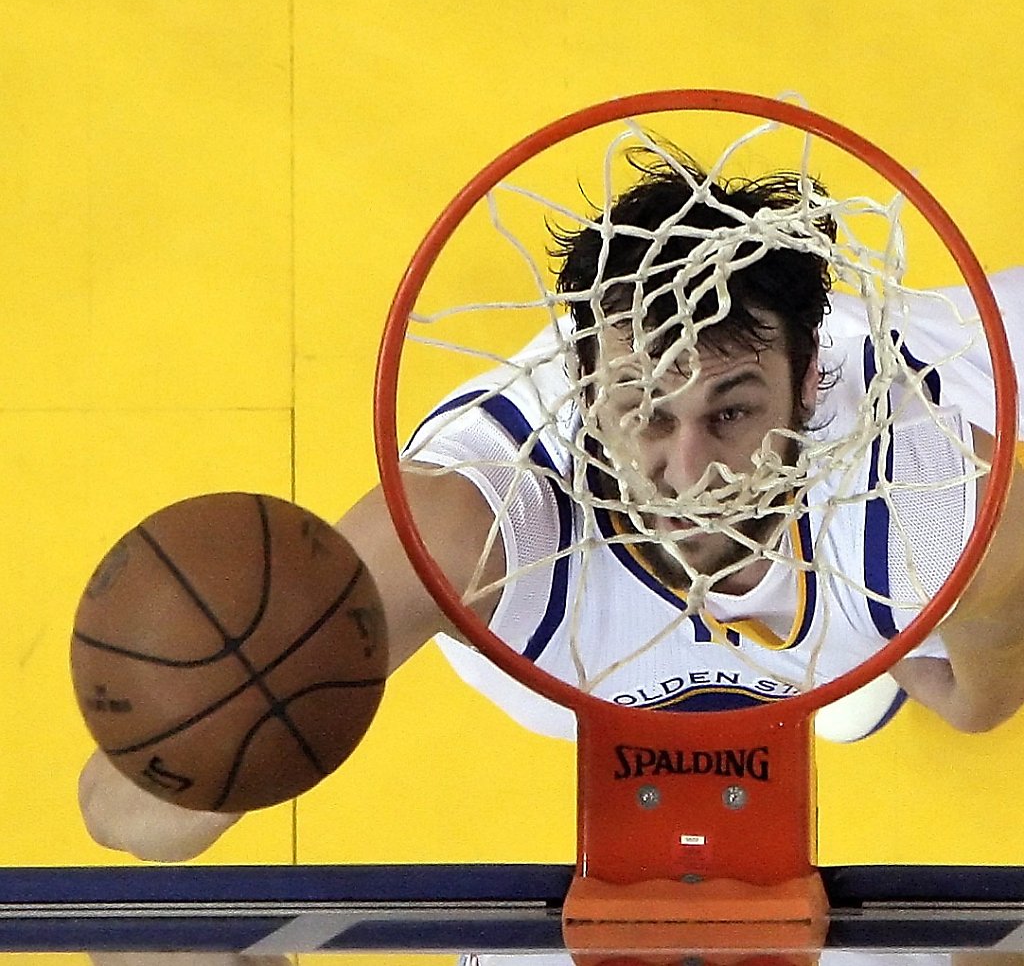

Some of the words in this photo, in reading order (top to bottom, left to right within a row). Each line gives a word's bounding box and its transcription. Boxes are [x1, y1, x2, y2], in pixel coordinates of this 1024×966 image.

[613, 671, 739, 706] OLDEN
[754, 679, 800, 695] ST
[613, 744, 769, 781] SPALDING
